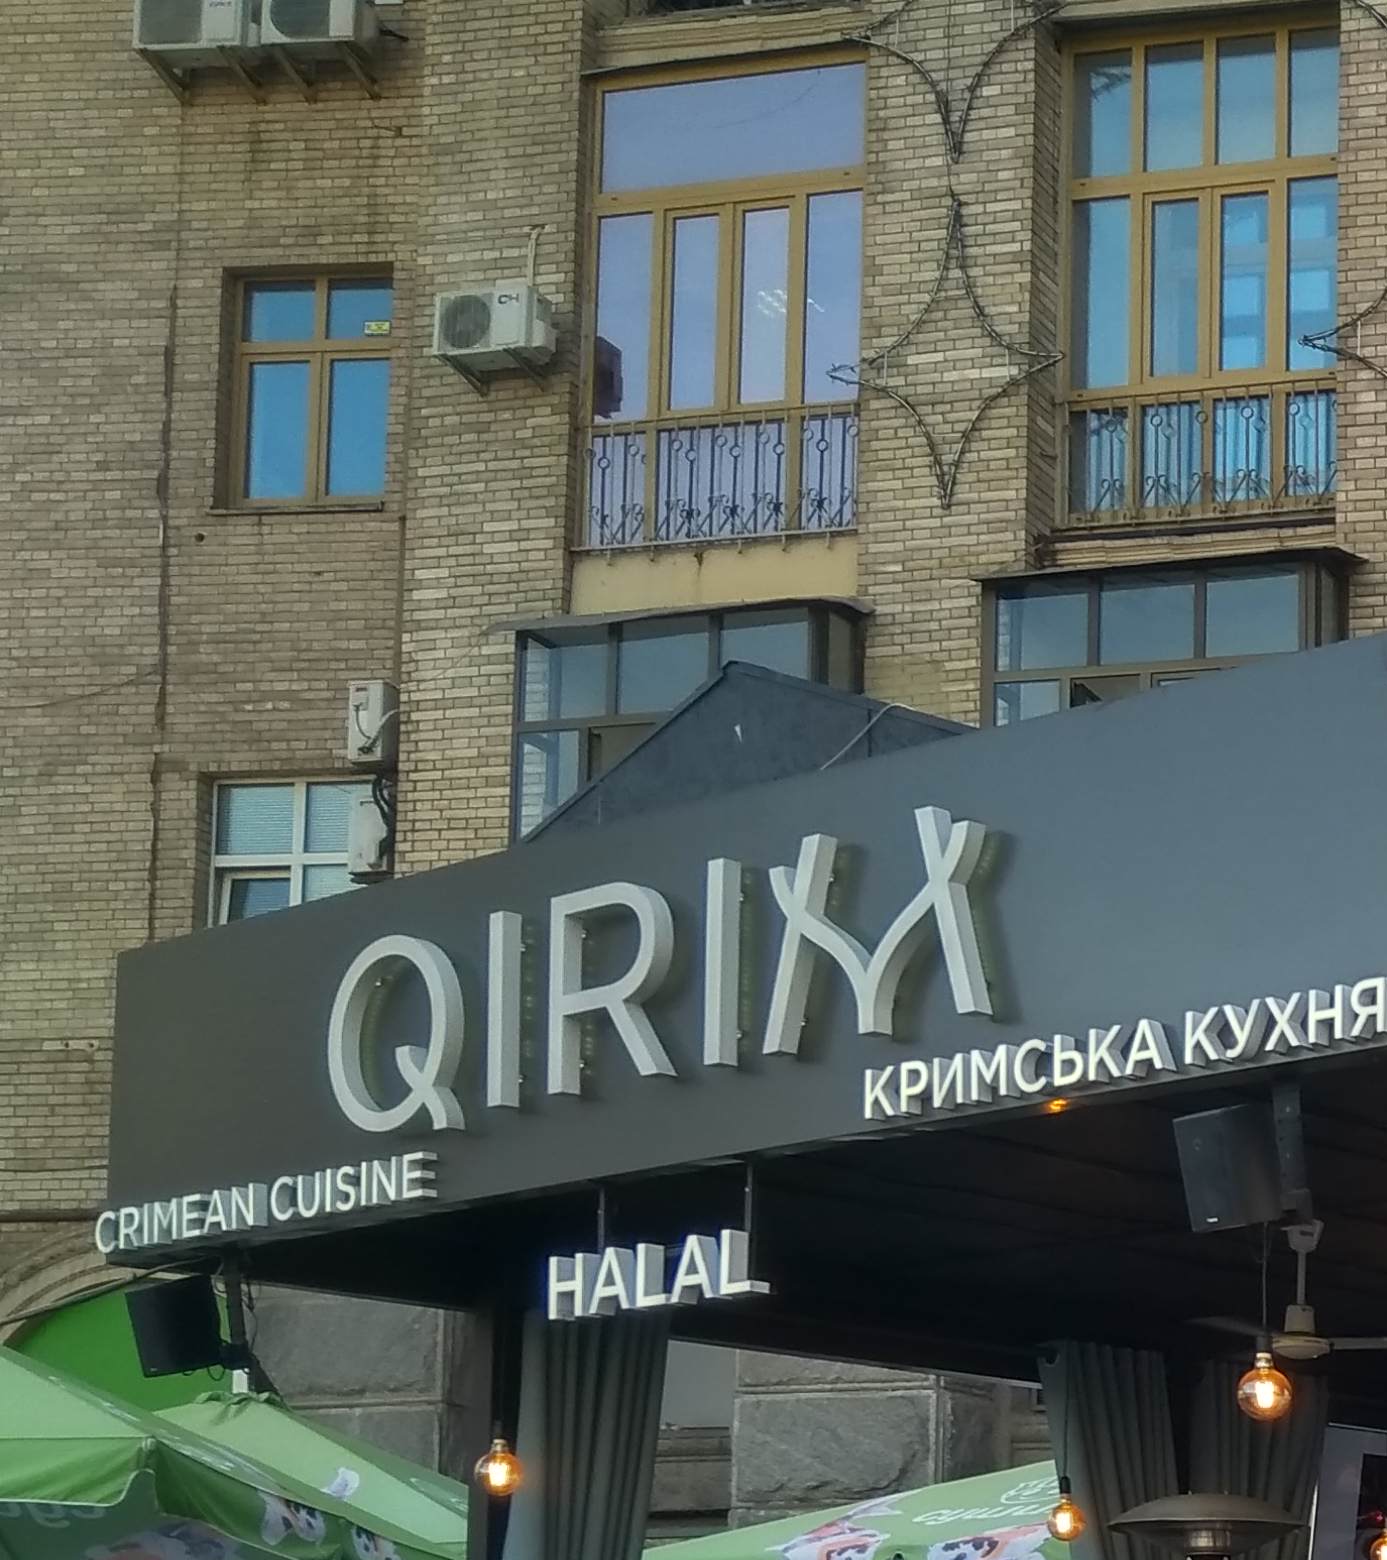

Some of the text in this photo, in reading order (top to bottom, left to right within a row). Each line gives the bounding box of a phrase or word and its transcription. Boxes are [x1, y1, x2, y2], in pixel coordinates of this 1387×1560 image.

[327, 805, 993, 1132] QIRIM
[863, 1018, 1177, 1121] КРИМСЬКА
[94, 1151, 438, 1255] CRIMEAN CUISINE
[546, 1228, 771, 1321] HALAL
